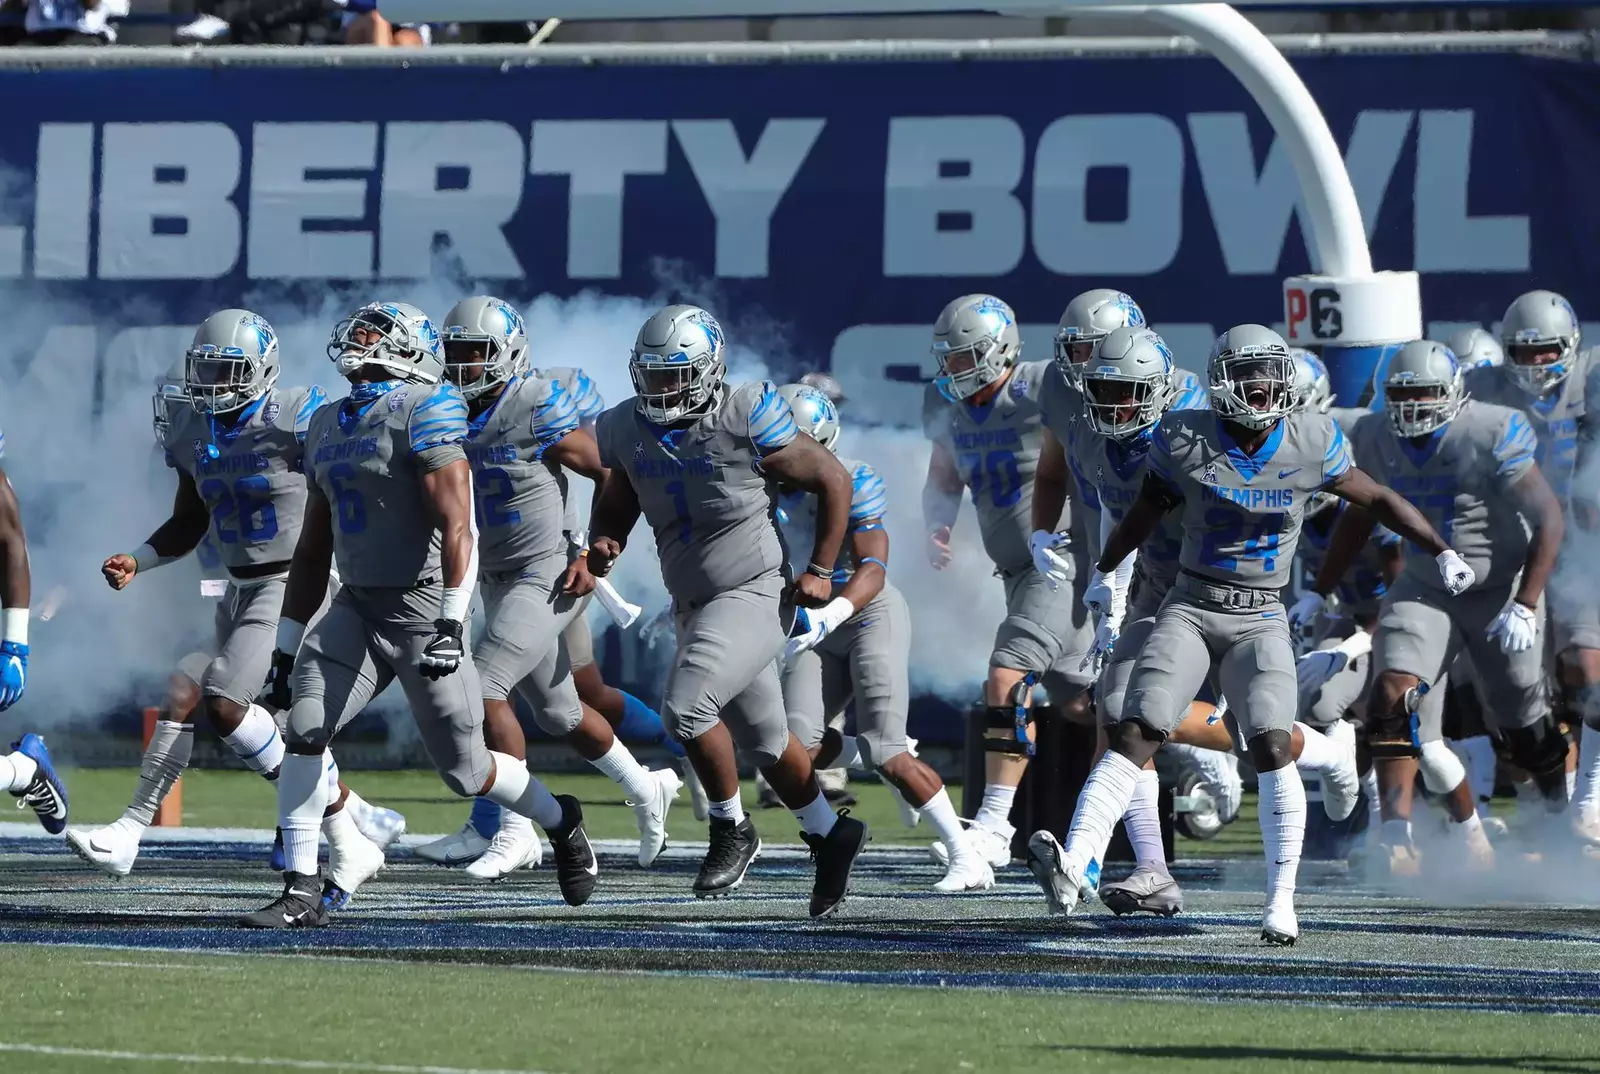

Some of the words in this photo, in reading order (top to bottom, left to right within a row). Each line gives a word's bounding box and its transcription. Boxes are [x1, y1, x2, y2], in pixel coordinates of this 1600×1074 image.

[0, 118, 826, 280] IBERTY
[883, 109, 1531, 277] BOWL
[313, 437, 378, 464] MEMPHIS
[958, 450, 1022, 508] 70
[328, 463, 368, 534] 6
[474, 467, 521, 527] 2
[664, 480, 693, 544] 1
[1201, 485, 1294, 508] MEMPHIS
[1199, 507, 1286, 572] 24
